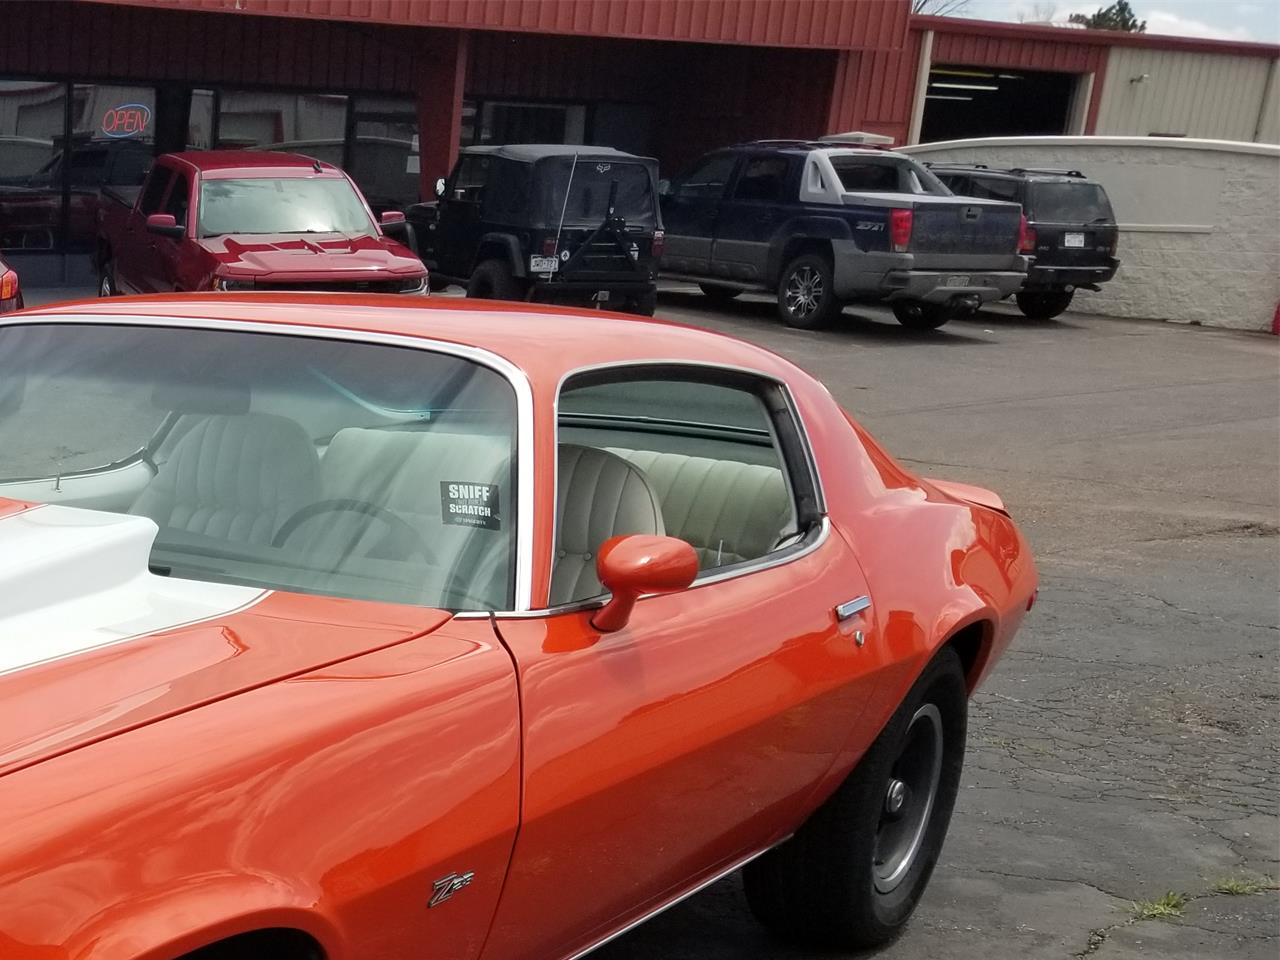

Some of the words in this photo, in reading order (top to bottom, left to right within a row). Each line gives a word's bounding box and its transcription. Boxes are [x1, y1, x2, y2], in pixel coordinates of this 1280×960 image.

[103, 109, 147, 132] OPEN
[448, 484, 490, 501] SNIFF
[449, 503, 492, 517] SCRATCH
